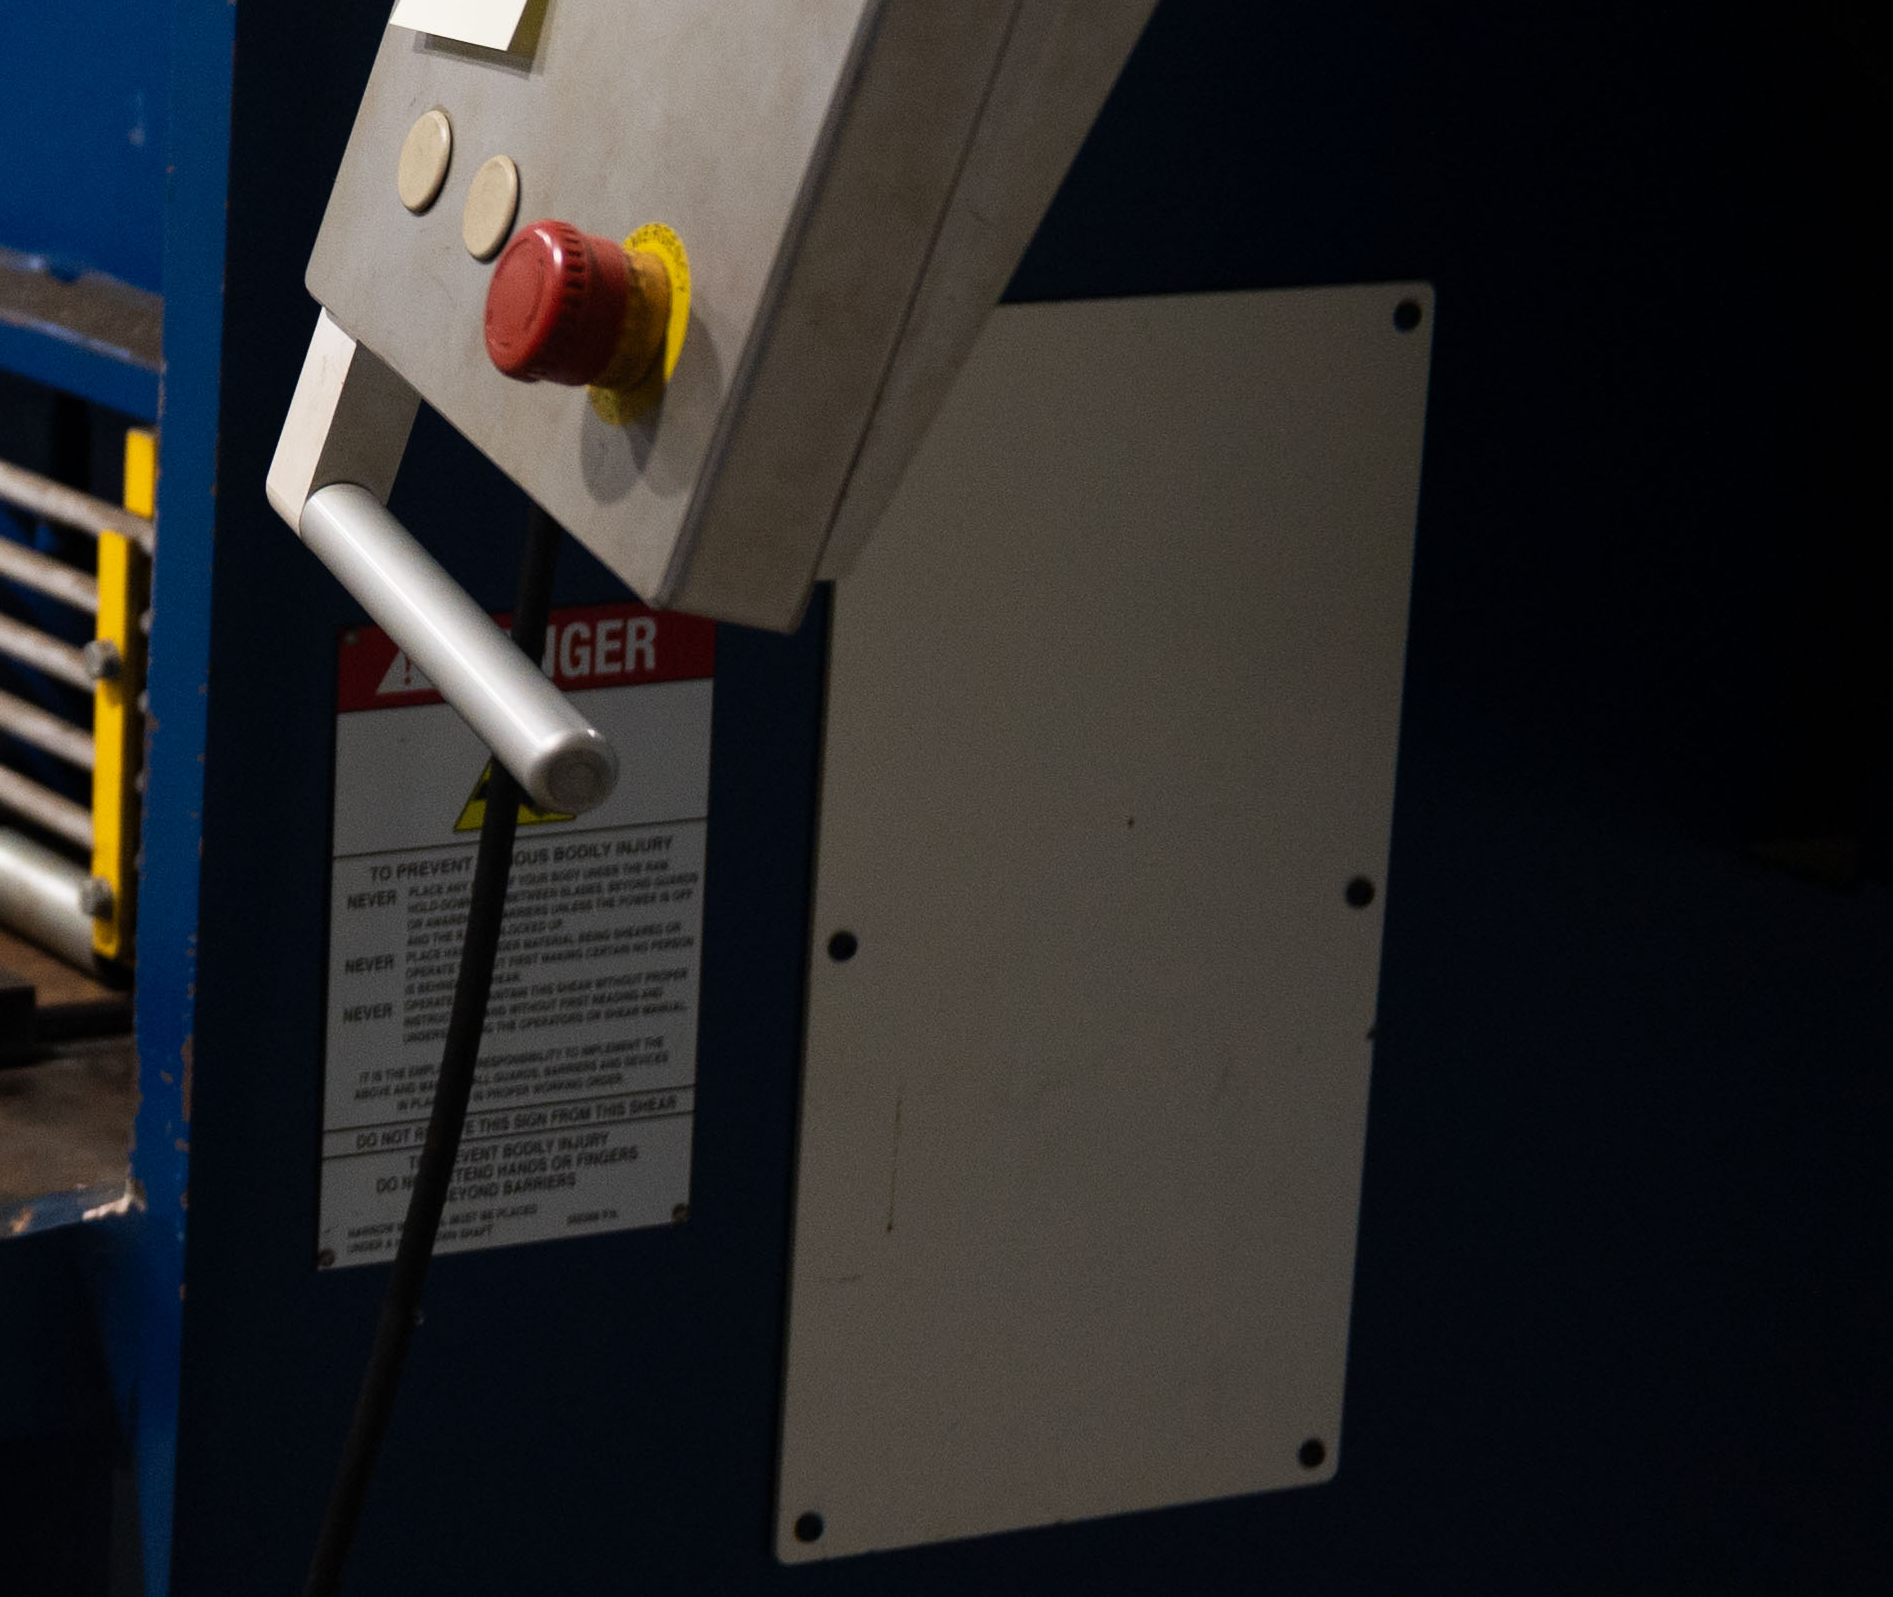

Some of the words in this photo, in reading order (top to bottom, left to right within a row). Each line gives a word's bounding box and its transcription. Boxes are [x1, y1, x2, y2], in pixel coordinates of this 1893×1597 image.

[371, 864, 391, 882] TO
[396, 856, 473, 879] PREVENT
[554, 841, 611, 862] BODILY
[616, 835, 673, 856] INJURY
[347, 889, 397, 909] NEVER
[345, 954, 395, 974] NEVER
[343, 1003, 393, 1023] NEVER
[356, 1133, 377, 1150] DO
[381, 1128, 411, 1147] NOT
[480, 1116, 510, 1134] THIS
[514, 1111, 547, 1130] SIGN
[551, 1105, 591, 1125] FROM
[596, 1100, 626, 1119] THIS
[629, 1094, 677, 1115] SHEAR
[503, 1138, 554, 1159] BODILY
[559, 1131, 609, 1152] INJURY
[376, 1176, 397, 1194] DO
[497, 1157, 547, 1179] HANDS
[551, 1154, 571, 1172] OR
[577, 1145, 639, 1168] FINGERS
[503, 1171, 576, 1196] BARRIERS
